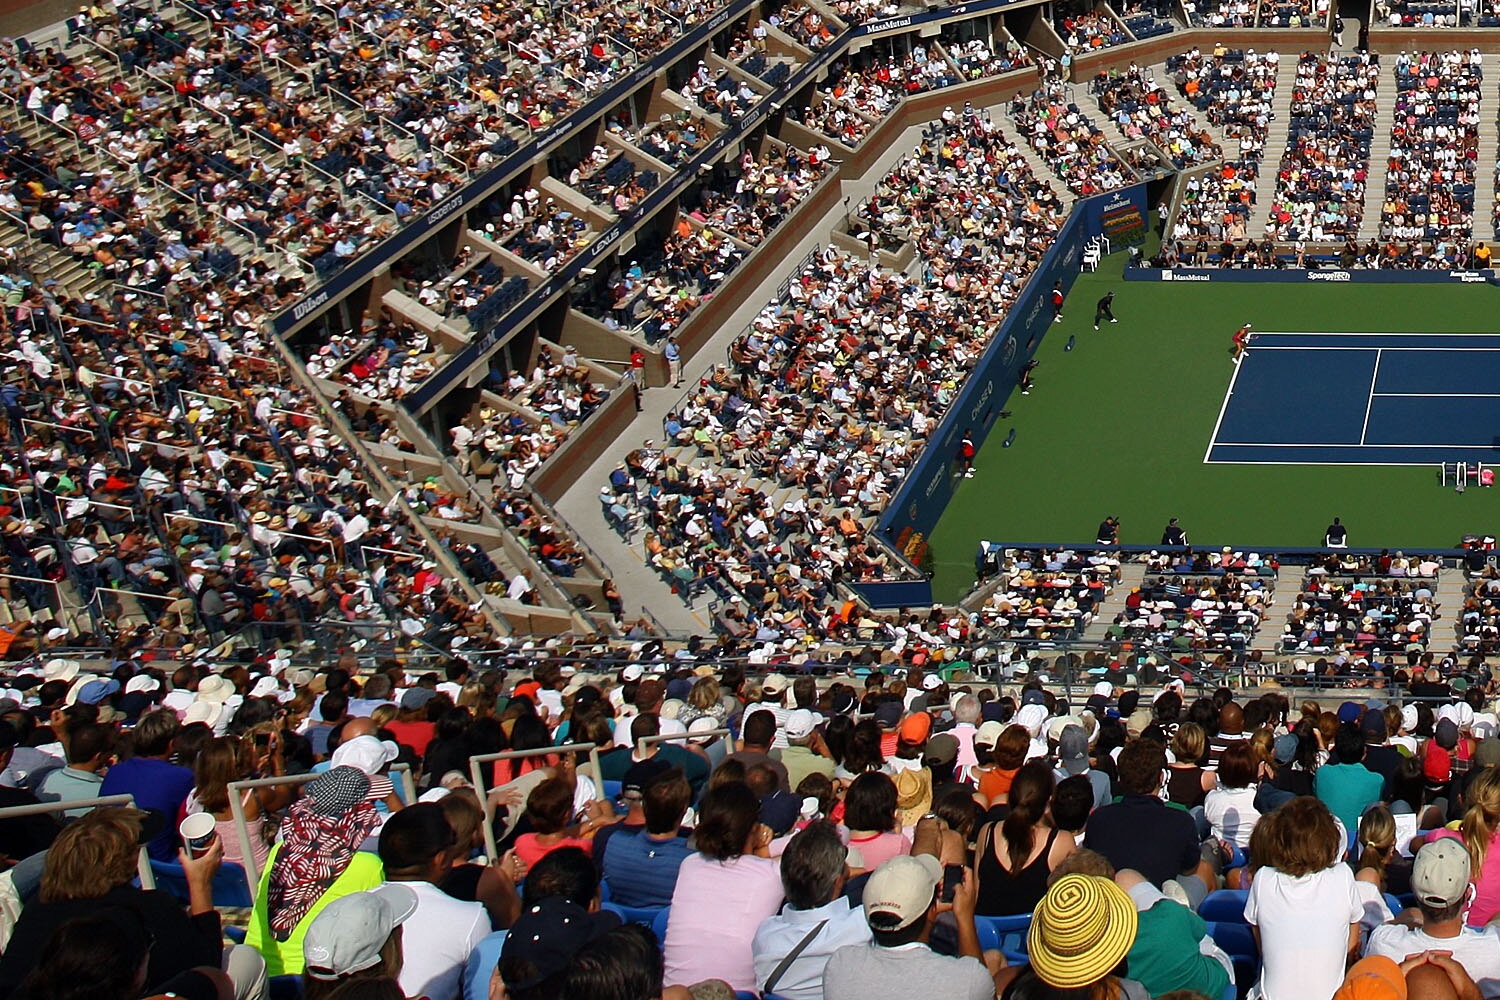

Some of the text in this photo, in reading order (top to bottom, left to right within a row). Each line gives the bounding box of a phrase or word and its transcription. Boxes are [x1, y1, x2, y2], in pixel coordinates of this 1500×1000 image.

[866, 16, 911, 33] MassMutual
[591, 227, 620, 256] LEXUS
[292, 291, 328, 320] Wilson
